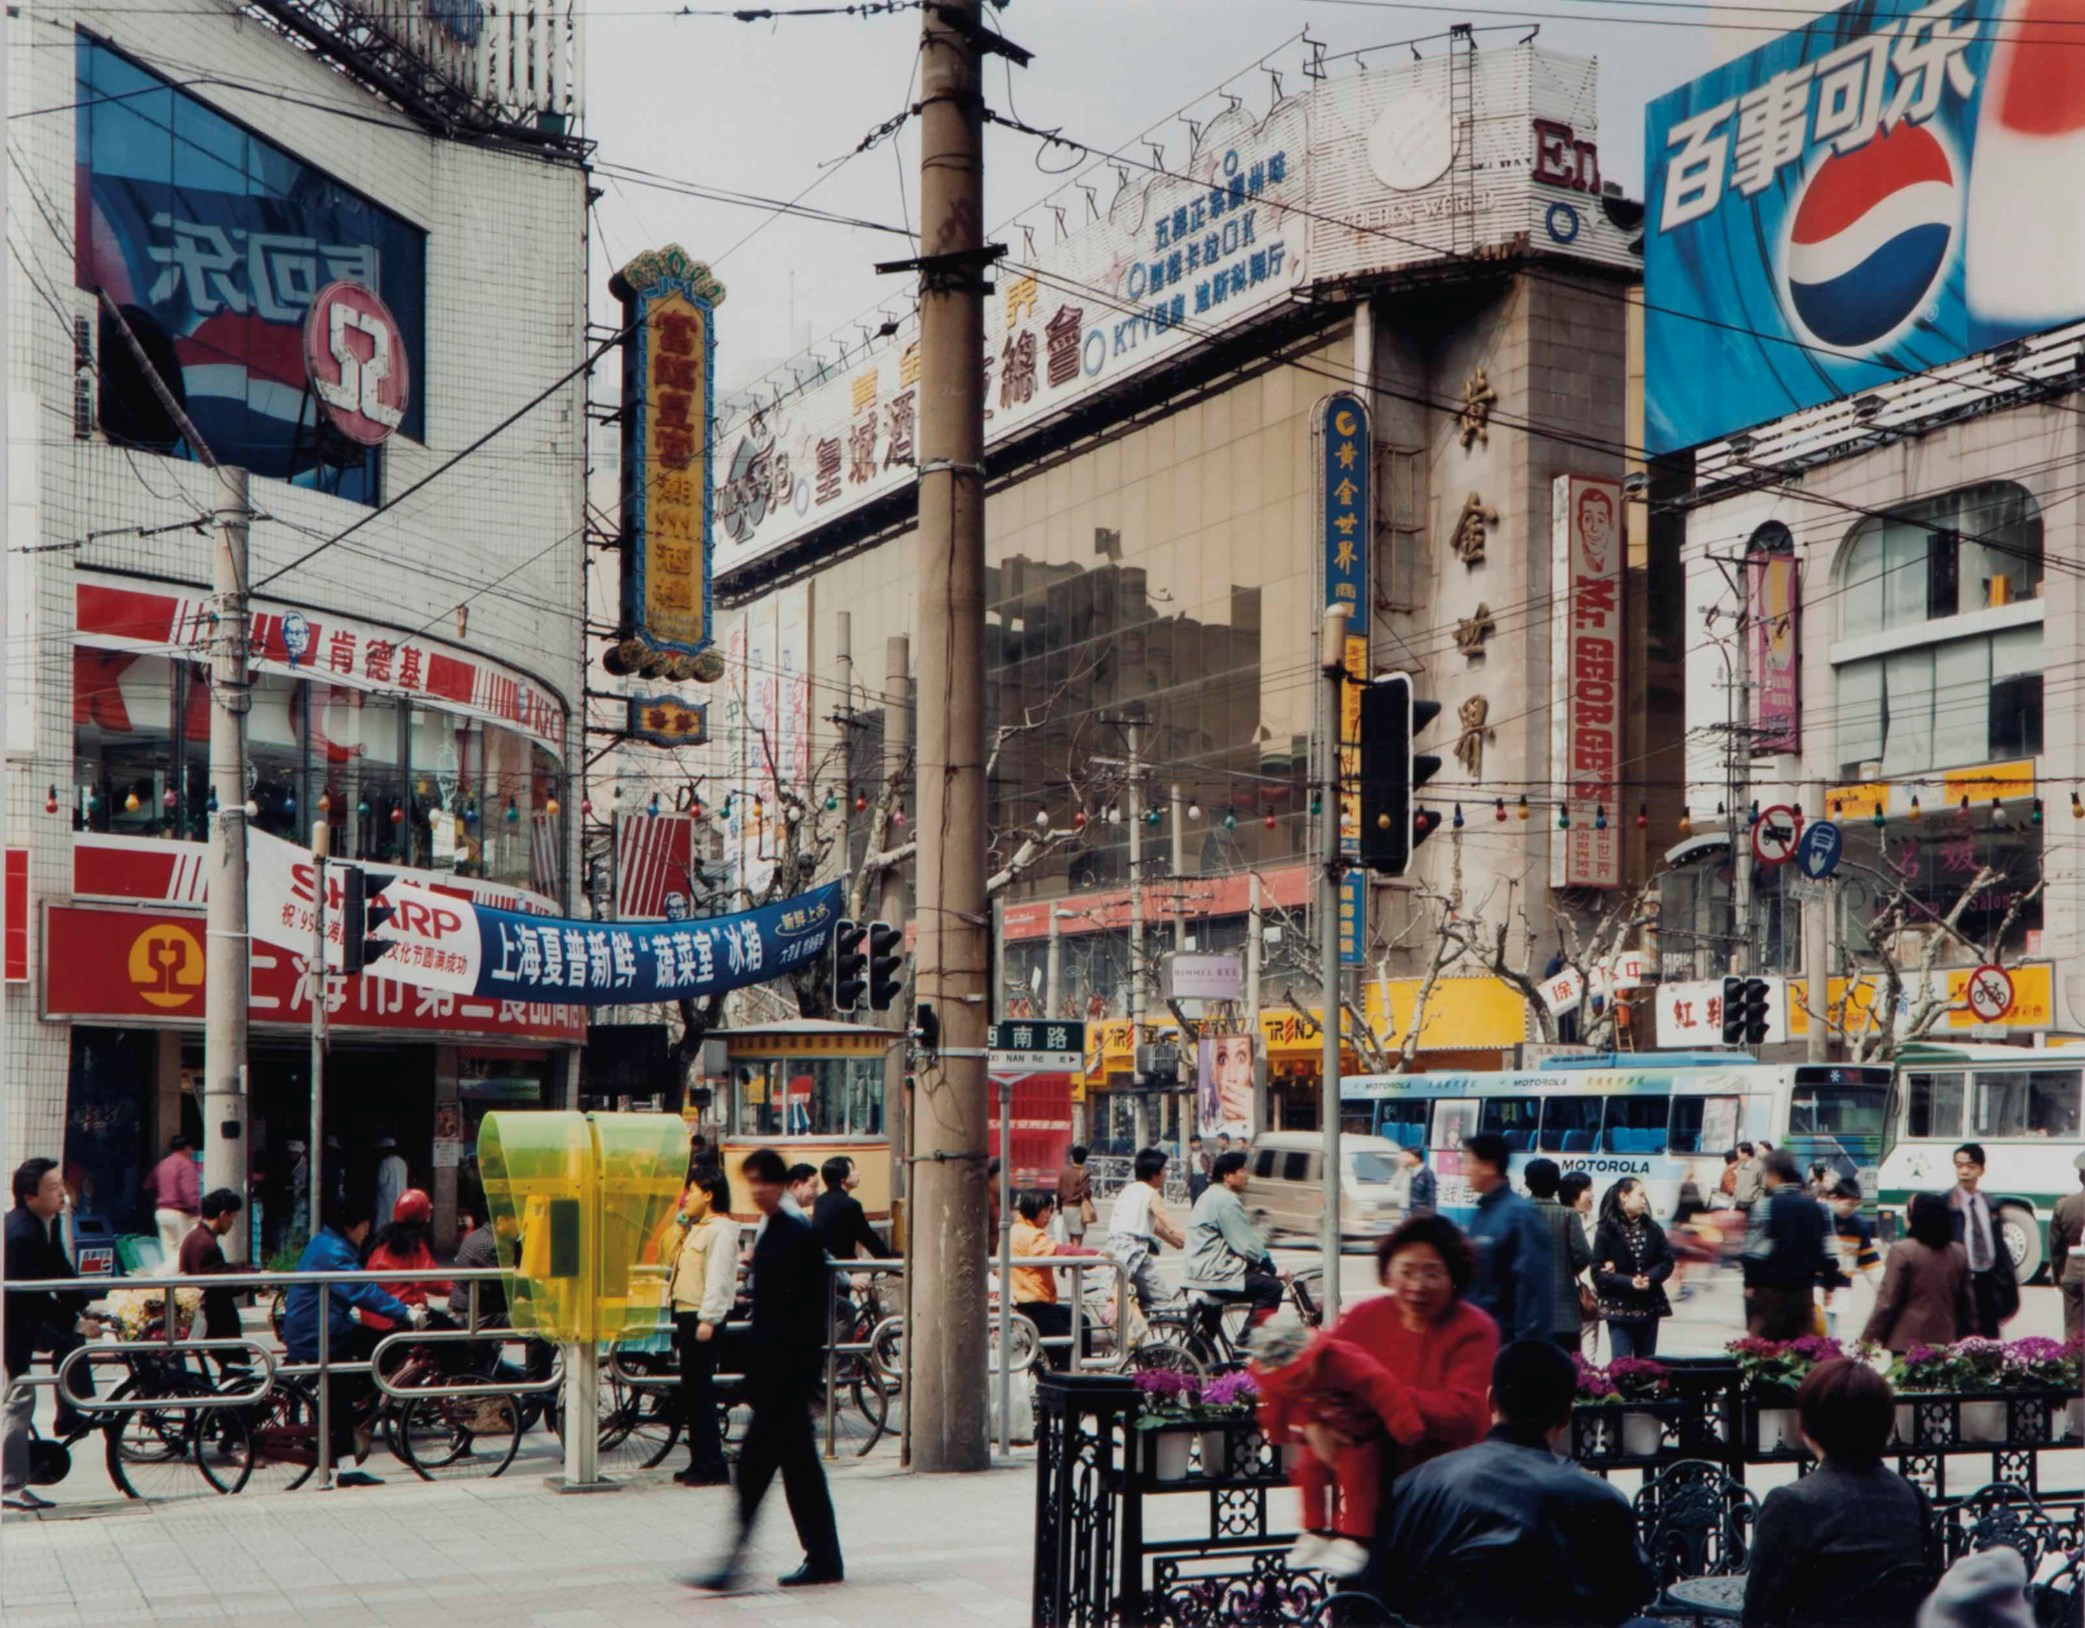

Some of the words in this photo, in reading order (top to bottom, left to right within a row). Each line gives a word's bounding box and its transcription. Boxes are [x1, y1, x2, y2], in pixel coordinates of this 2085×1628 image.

[1660, 2, 1980, 234] 百事可乐
[1575, 575, 1615, 629] Mr.
[329, 630, 426, 690] 肯德基
[291, 864, 461, 940] SHARP
[1265, 1016, 1315, 1045] TREND
[1006, 1054, 1025, 1062] NAN
[1032, 1054, 1043, 1063] Rd
[1364, 1082, 1412, 1090] MOTOROLA
[1512, 1078, 1568, 1087] MOTOROLA
[1561, 1159, 1650, 1174] MOTOROLA
